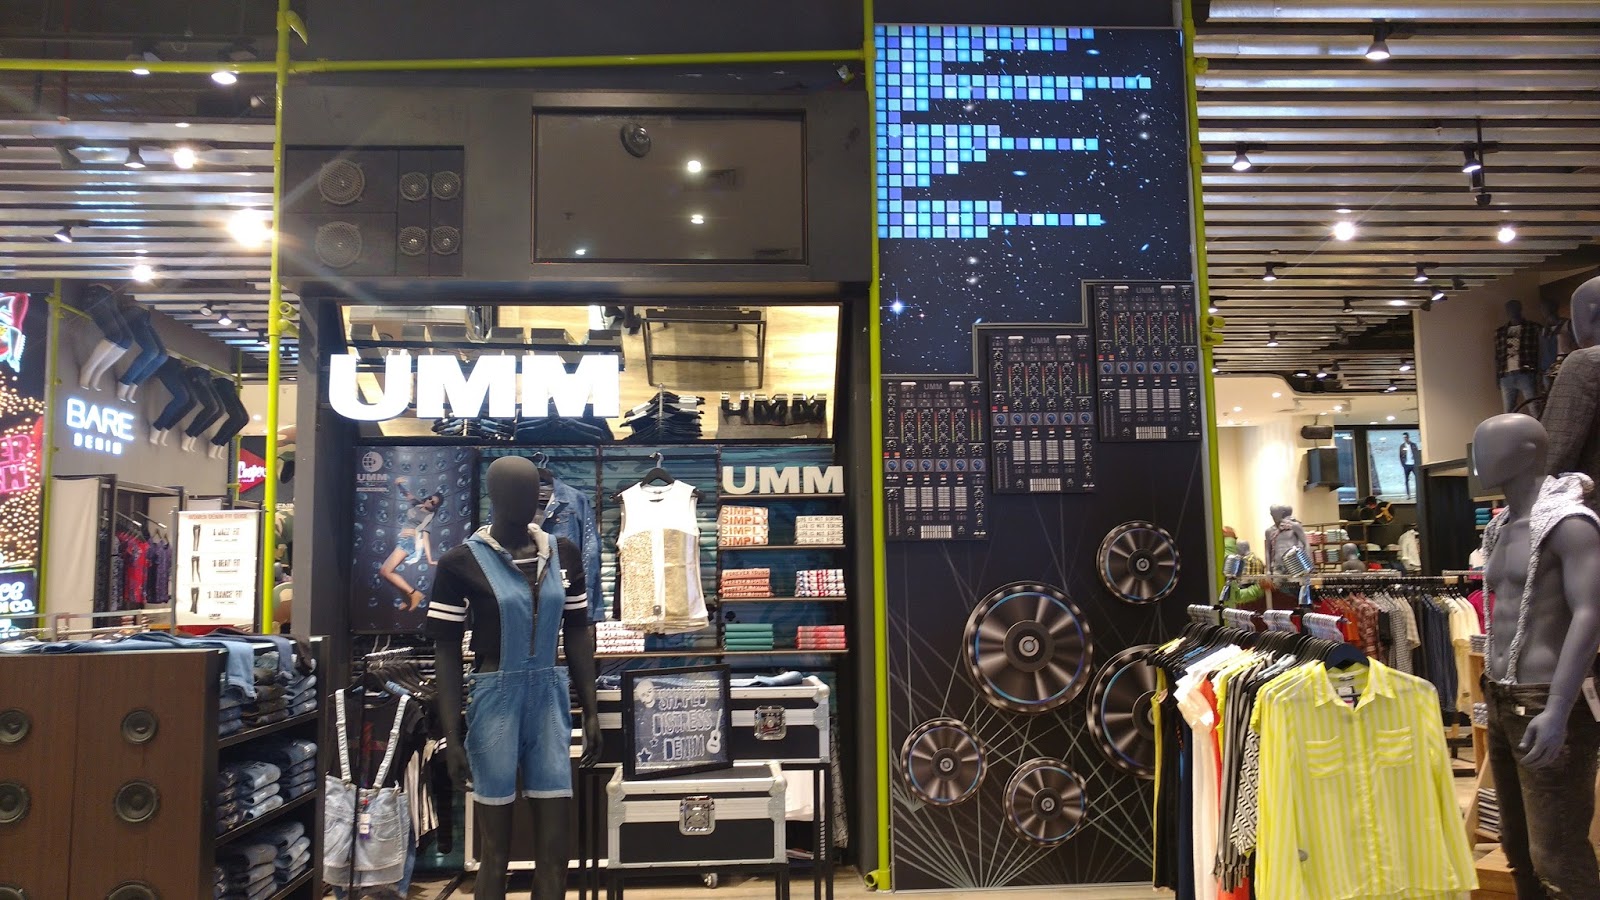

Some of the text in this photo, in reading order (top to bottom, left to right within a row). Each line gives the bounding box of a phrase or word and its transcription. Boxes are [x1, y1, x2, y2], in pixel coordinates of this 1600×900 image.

[329, 354, 620, 421] UMM
[66, 398, 135, 441] BARE
[356, 473, 388, 482] UMM
[722, 465, 844, 495] UMM
[721, 505, 768, 515] SIMPLY
[721, 515, 768, 525] SIMPLY
[721, 526, 768, 535] SIMPLY
[721, 536, 768, 546] SIMPLY
[652, 709, 713, 737] DISTRESS
[663, 734, 706, 761] DENIM
